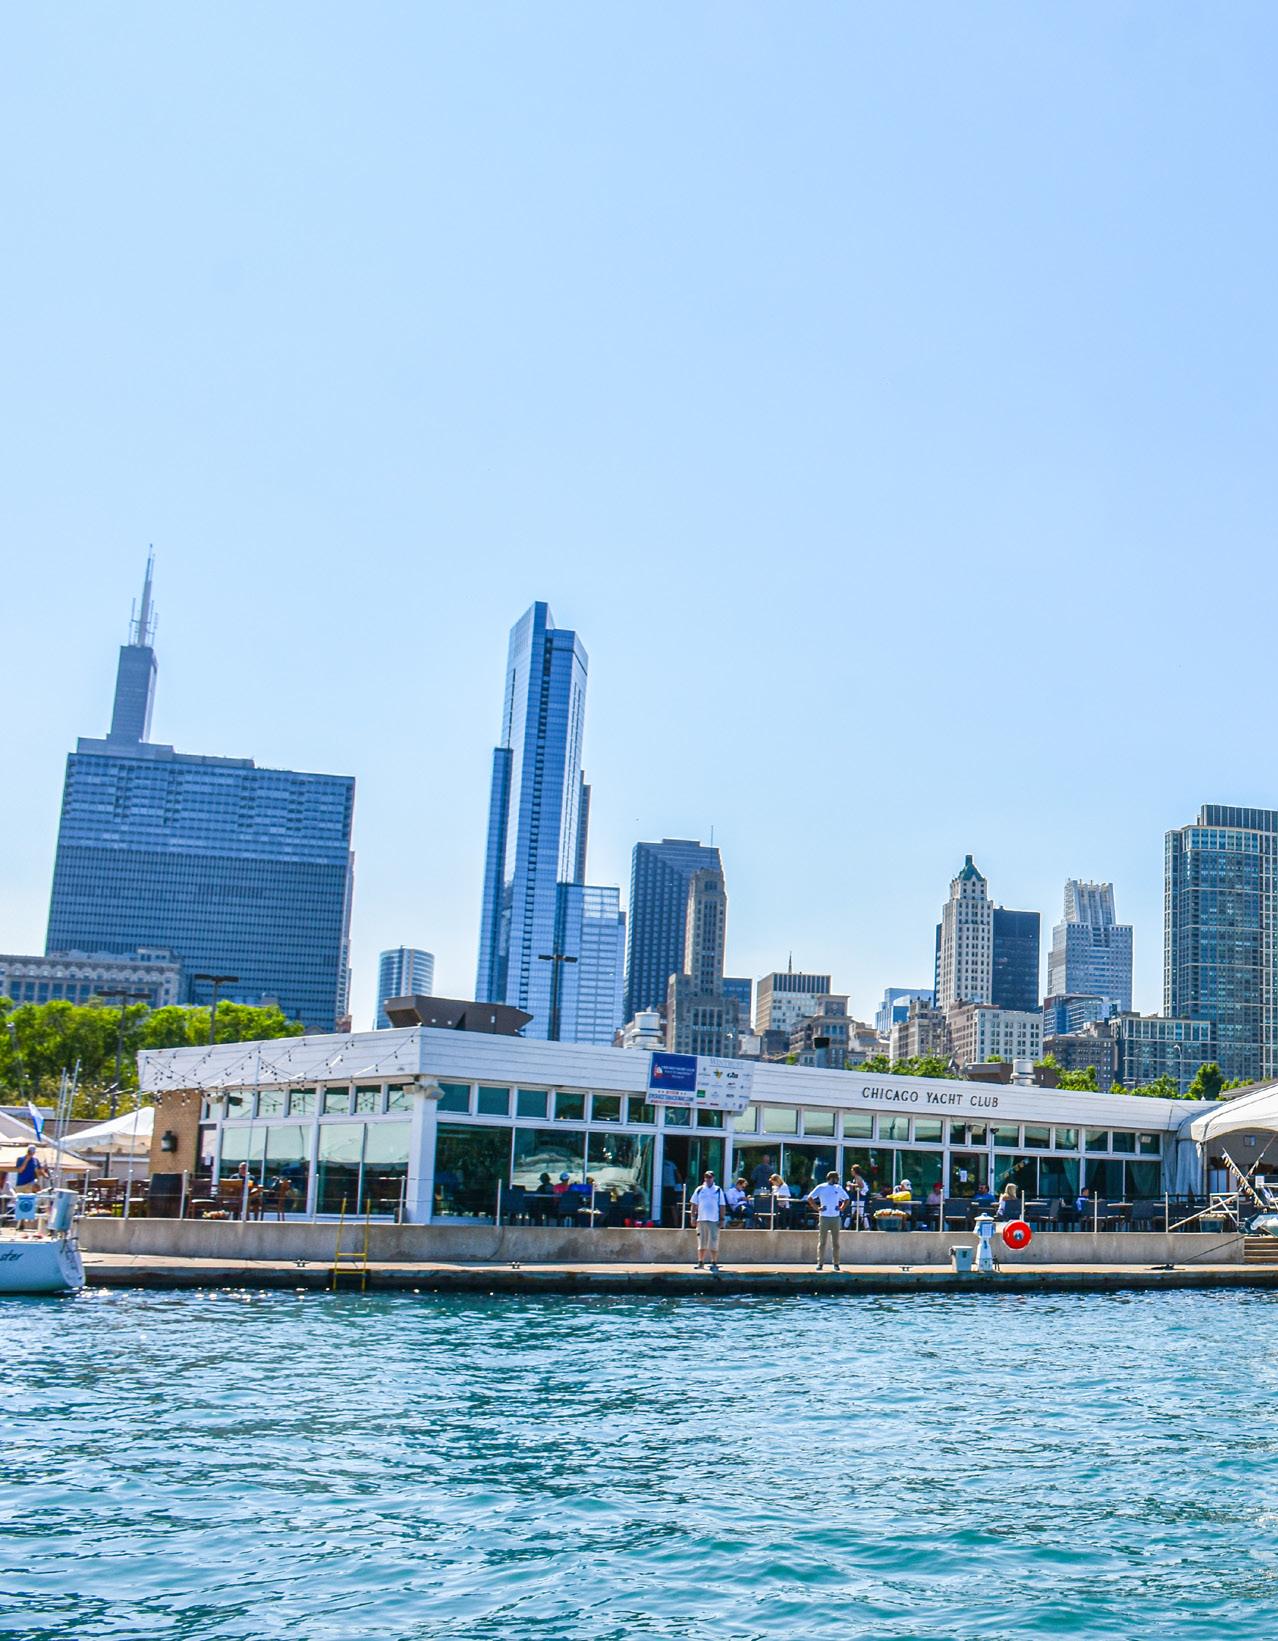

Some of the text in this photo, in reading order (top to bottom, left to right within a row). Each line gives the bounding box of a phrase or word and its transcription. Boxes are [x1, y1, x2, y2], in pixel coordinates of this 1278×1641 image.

[862, 1087, 999, 1107] CHICAGO YACHT CLUB
